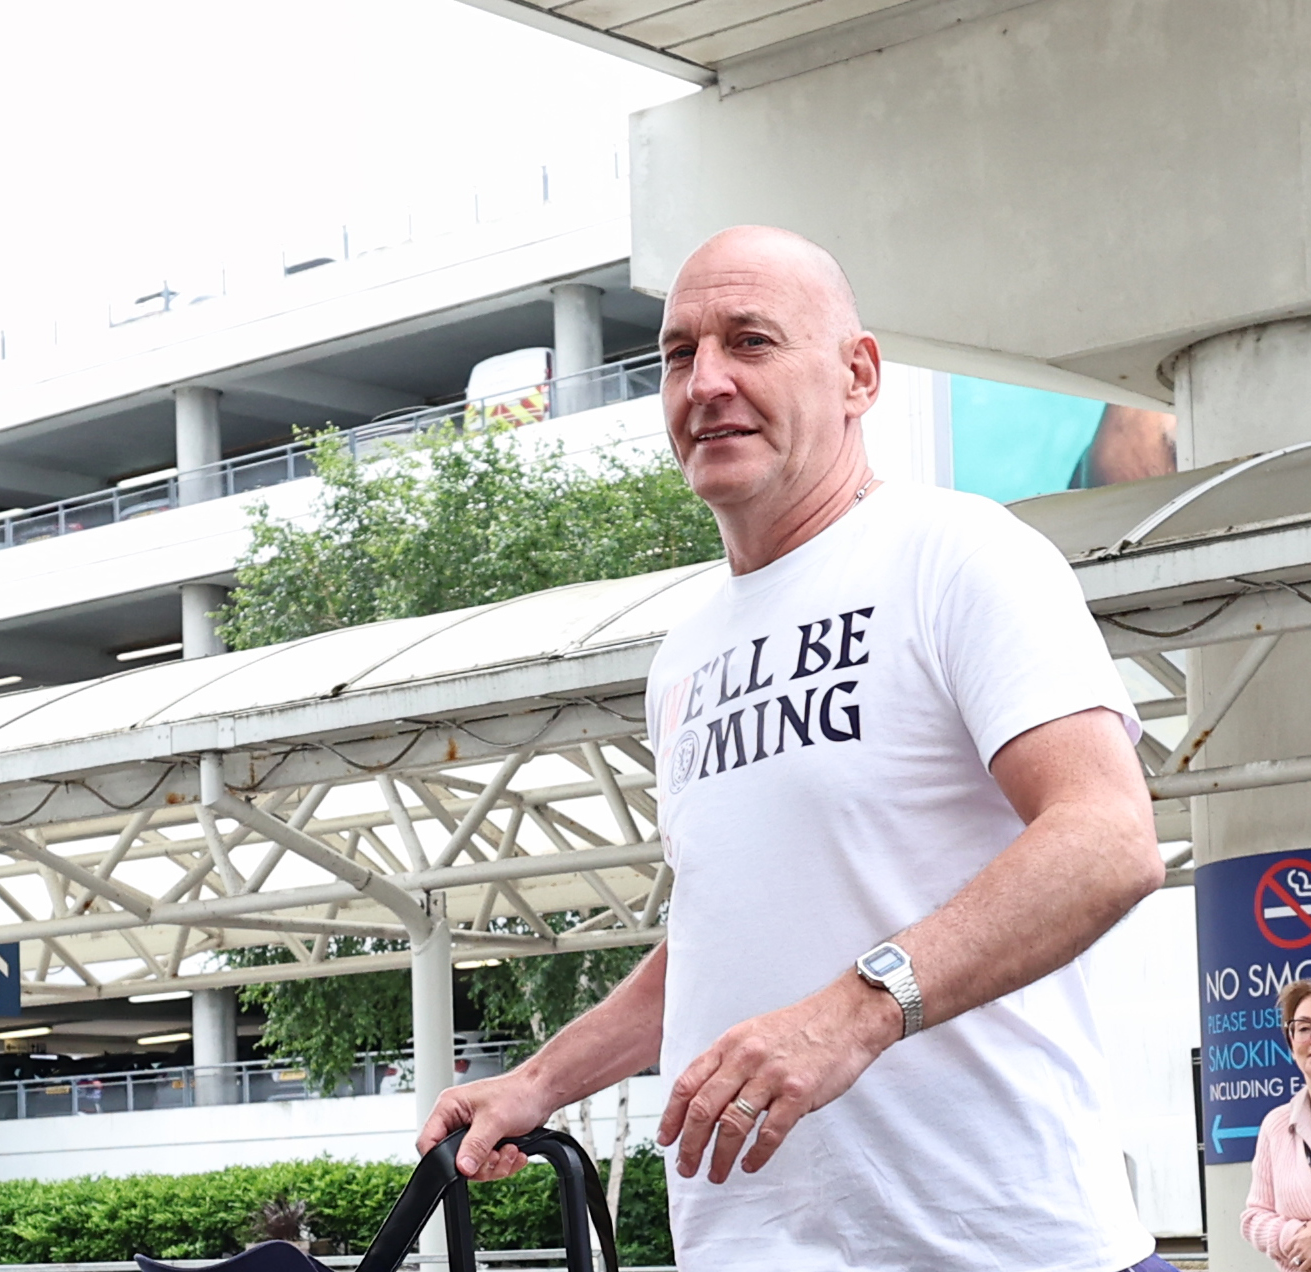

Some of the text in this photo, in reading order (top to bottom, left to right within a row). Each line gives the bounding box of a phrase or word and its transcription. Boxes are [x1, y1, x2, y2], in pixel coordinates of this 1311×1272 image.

[789, 606, 875, 681] BE
[661, 681, 861, 794] MING
[1205, 967, 1240, 1003] NO
[1207, 1010, 1247, 1034] PLEASE
[1252, 1007, 1283, 1029] USE
[1208, 1039, 1293, 1073] SMOKIN
[1209, 1077, 1284, 1101] INCLUDING
